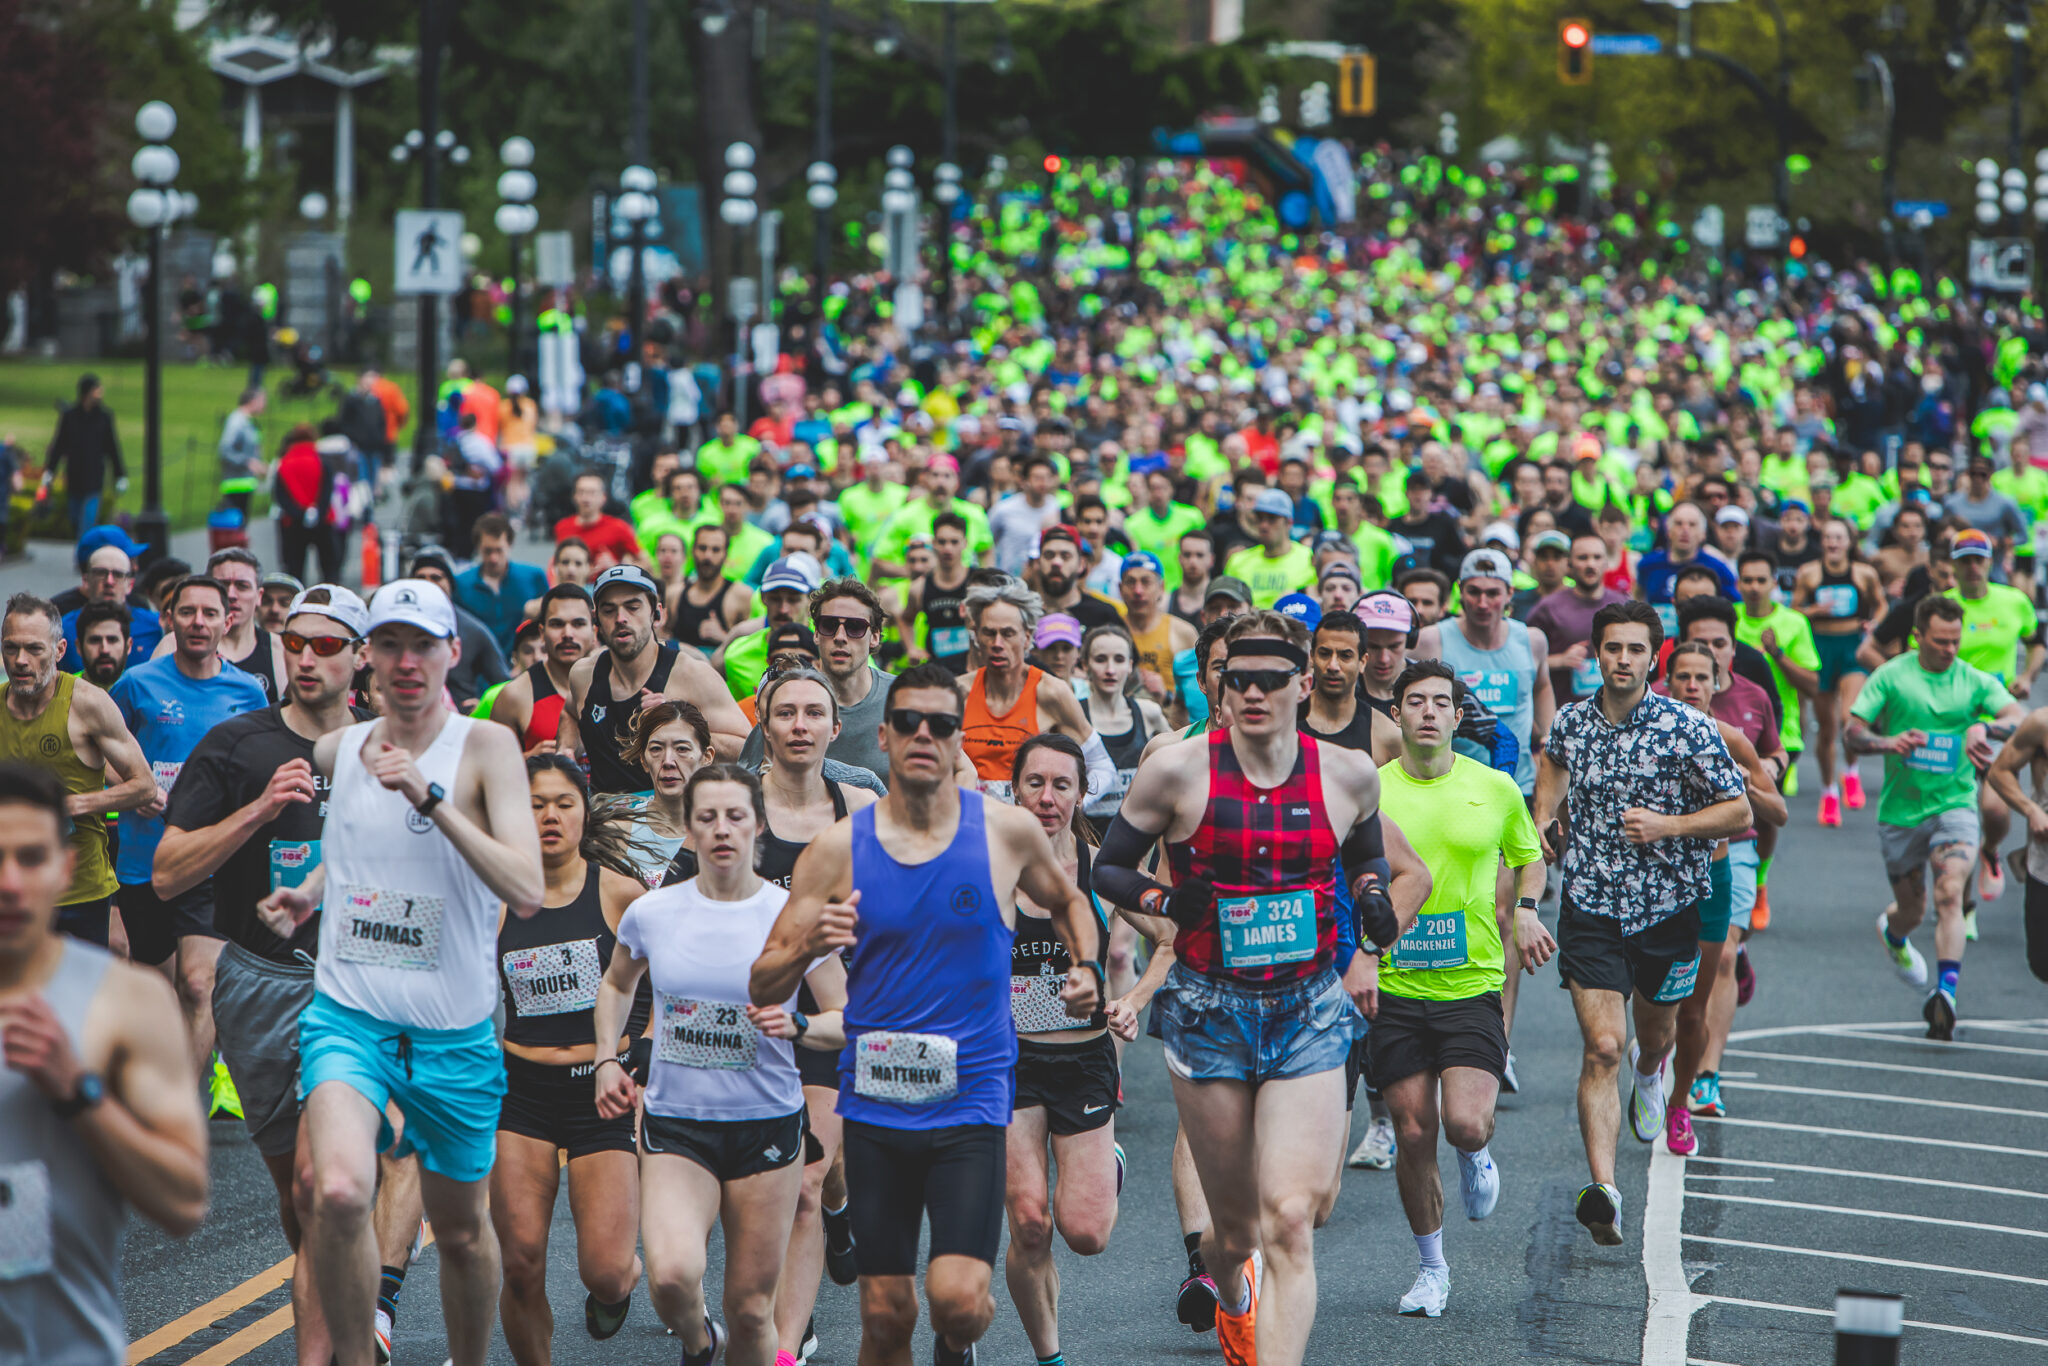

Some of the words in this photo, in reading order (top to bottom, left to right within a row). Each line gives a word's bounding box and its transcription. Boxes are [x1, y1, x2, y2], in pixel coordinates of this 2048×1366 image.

[1230, 909, 1251, 918] 10K
[1268, 898, 1304, 922] 324
[352, 918, 424, 947] THOMAS
[1243, 923, 1297, 946] JAMES
[1427, 918, 1456, 936] 209
[1400, 938, 1457, 951] MACKENZIE
[561, 949, 572, 966] 3
[716, 1008, 737, 1026] 23
[674, 1026, 744, 1050] MAKENNA
[918, 1042, 927, 1059] 2
[571, 1064, 595, 1078] NIK
[871, 1065, 941, 1084] MATTHEW
